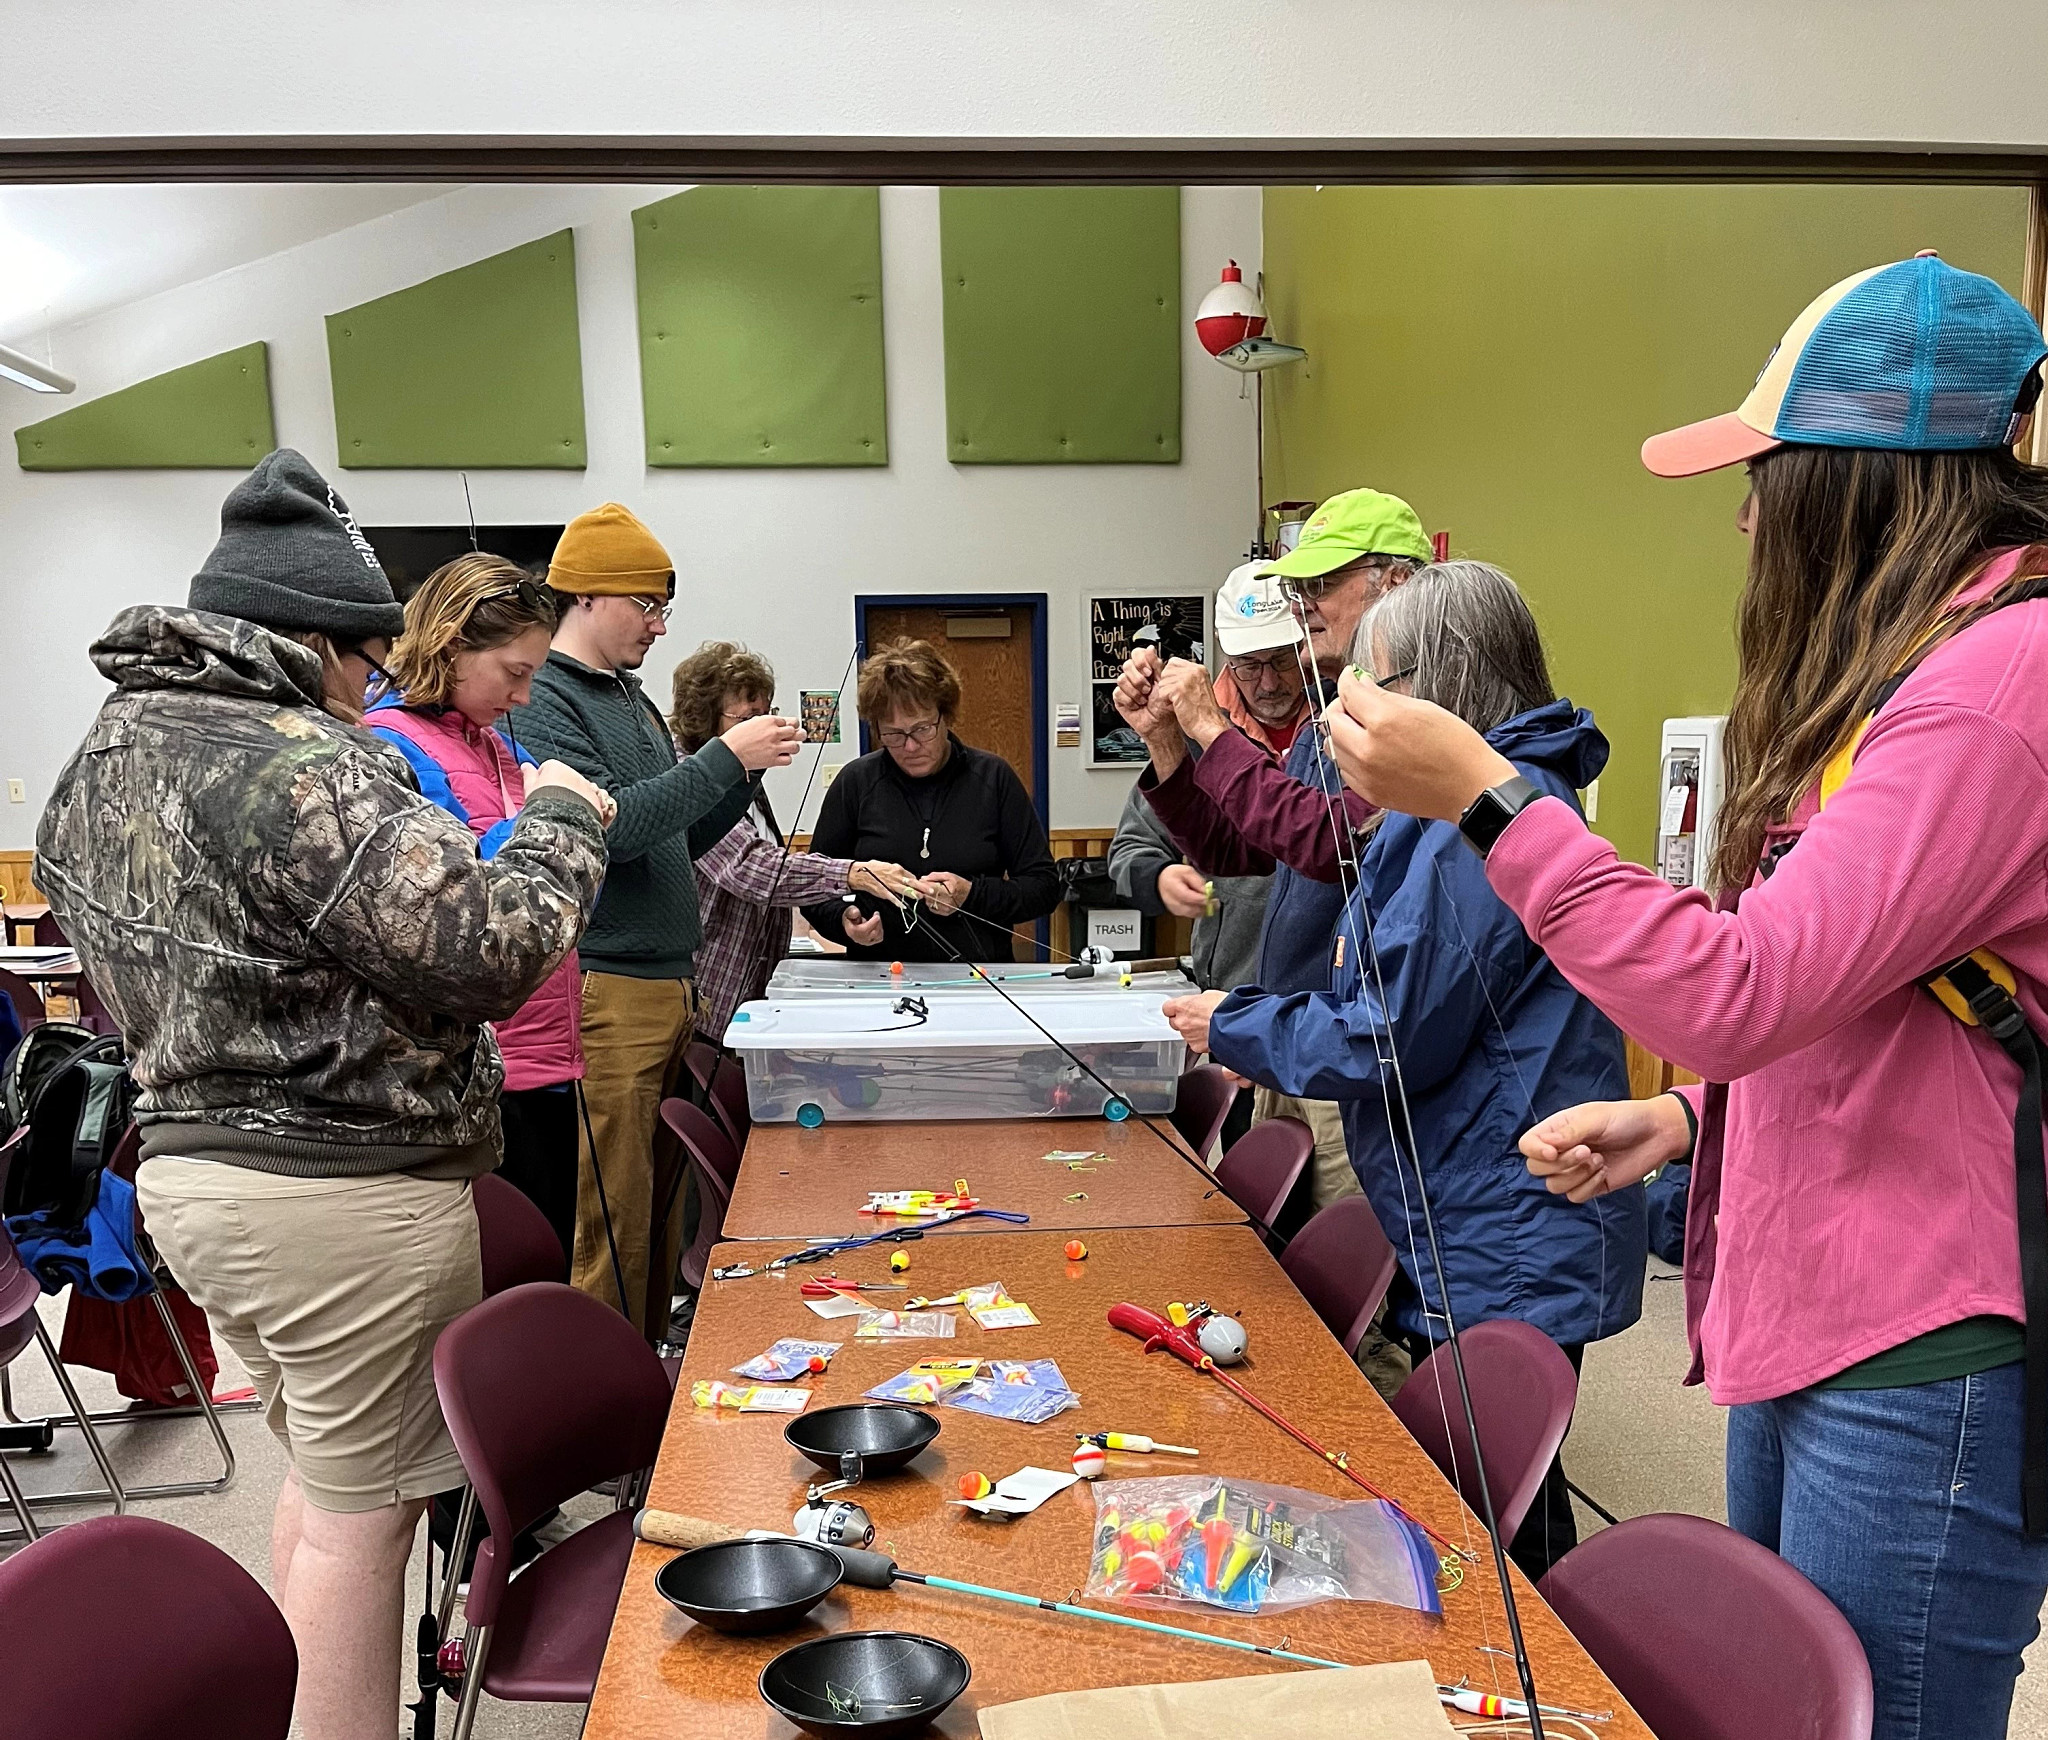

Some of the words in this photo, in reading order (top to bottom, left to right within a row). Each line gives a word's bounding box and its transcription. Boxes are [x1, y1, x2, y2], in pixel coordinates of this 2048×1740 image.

[1110, 600, 1151, 626] Thing
[1160, 603, 1172, 617] is
[1093, 625, 1126, 654] Right
[1095, 924, 1134, 935] TRASH
